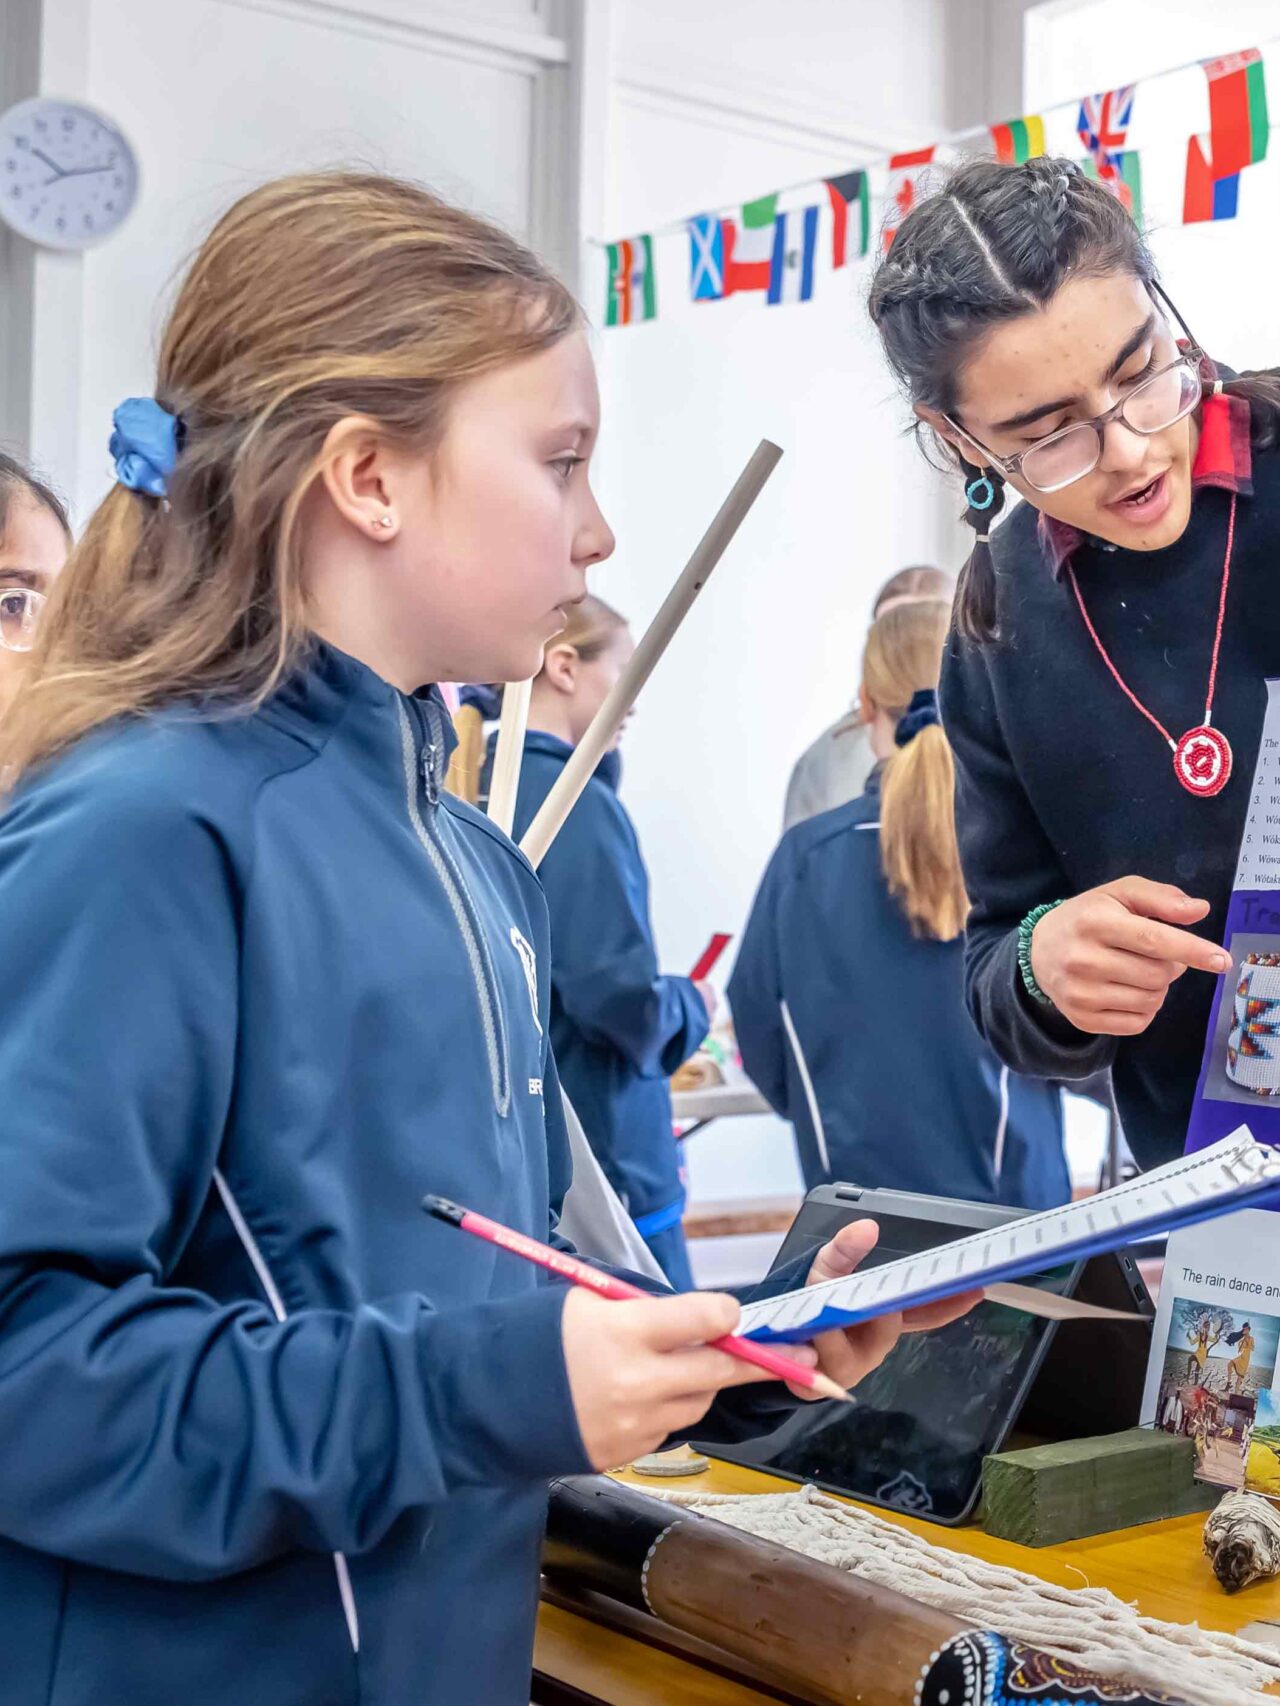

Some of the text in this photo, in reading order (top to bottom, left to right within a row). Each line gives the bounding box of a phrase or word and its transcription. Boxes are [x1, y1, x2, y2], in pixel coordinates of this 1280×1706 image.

[1264, 738, 1278, 747] The
[1182, 1267, 1202, 1283] The
[1205, 1274, 1225, 1287] rain
[1228, 1277, 1262, 1294] dance
